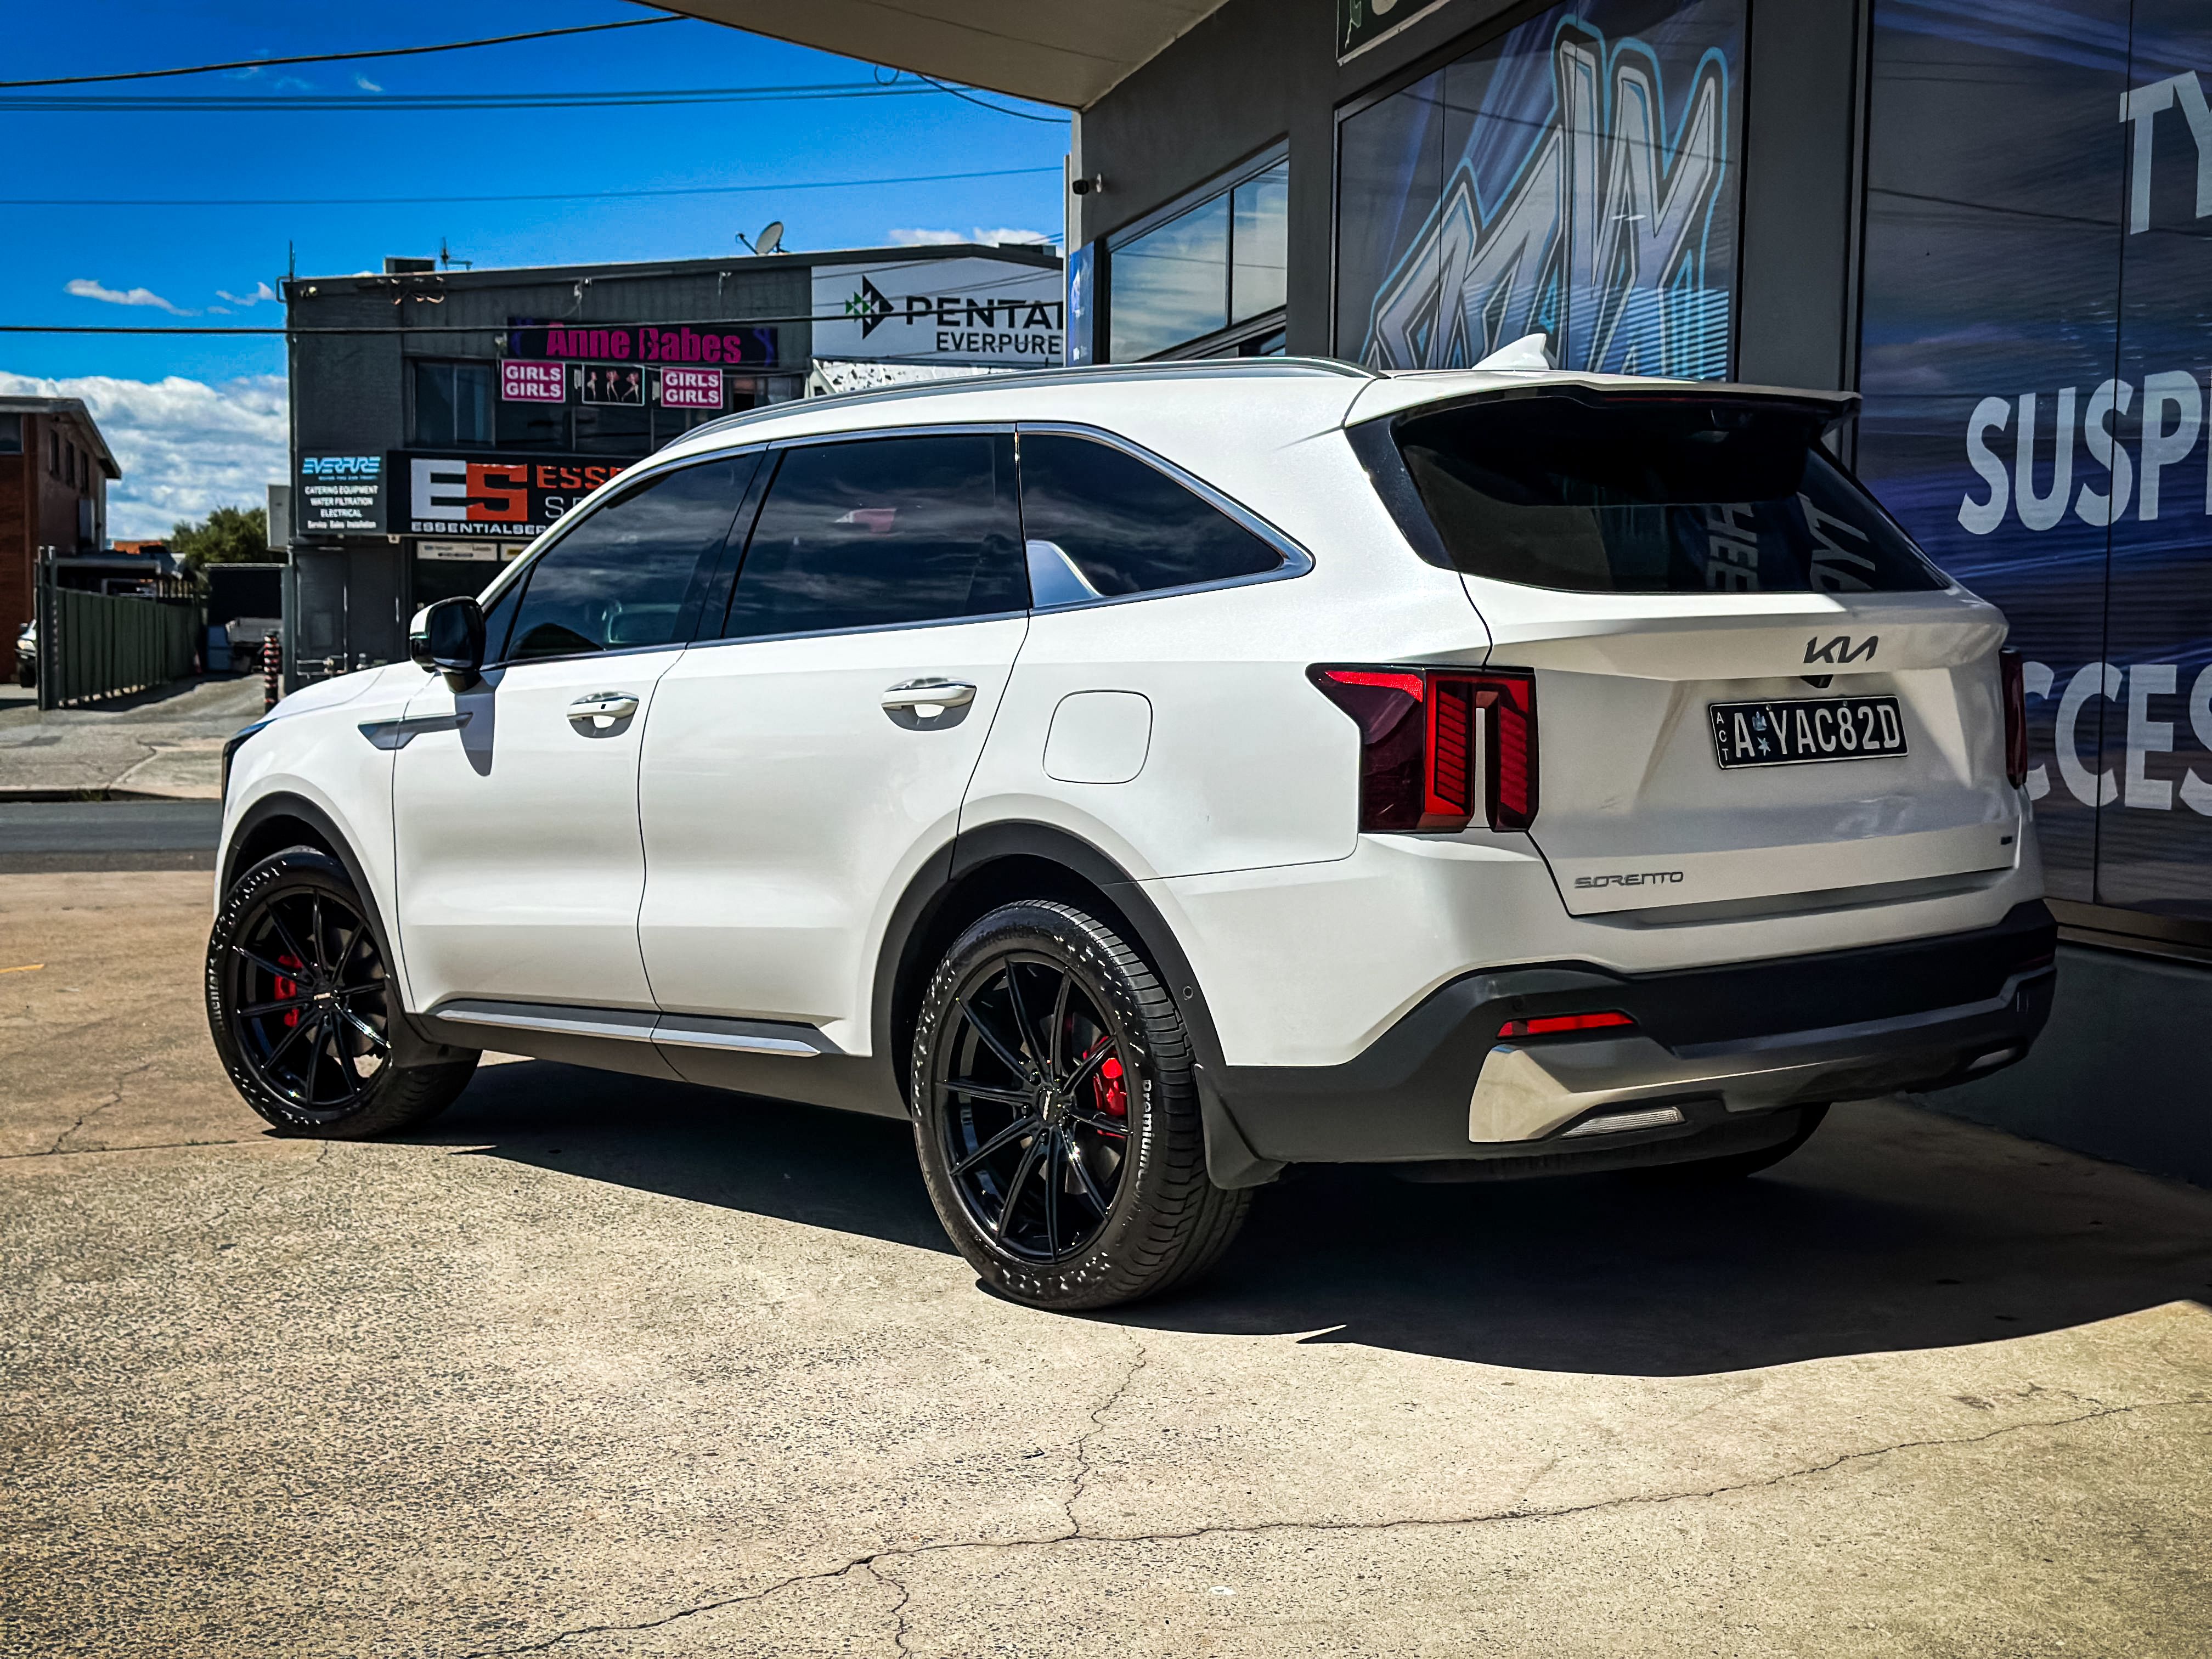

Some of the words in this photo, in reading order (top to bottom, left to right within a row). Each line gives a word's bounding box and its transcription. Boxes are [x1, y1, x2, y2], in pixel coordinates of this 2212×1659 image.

[546, 322, 630, 359] Anne
[936, 331, 1061, 354] EVERPURE
[506, 365, 562, 381] GIRLS
[665, 371, 719, 387] GIRLS
[506, 382, 562, 398] GIRLS
[665, 389, 719, 404] GIRLS
[1957, 370, 2212, 535] SUSP
[302, 456, 381, 474] EVERPURE
[304, 486, 338, 494] CATERING
[339, 486, 379, 494] EQUIPMENT
[410, 458, 528, 522] ES
[310, 497, 334, 506] WATER
[335, 497, 373, 506] FILTRATION
[320, 509, 363, 517] ELECTRICAL
[411, 522, 549, 535] ESSENTIALSER
[1575, 871, 1684, 889] SORENTO
